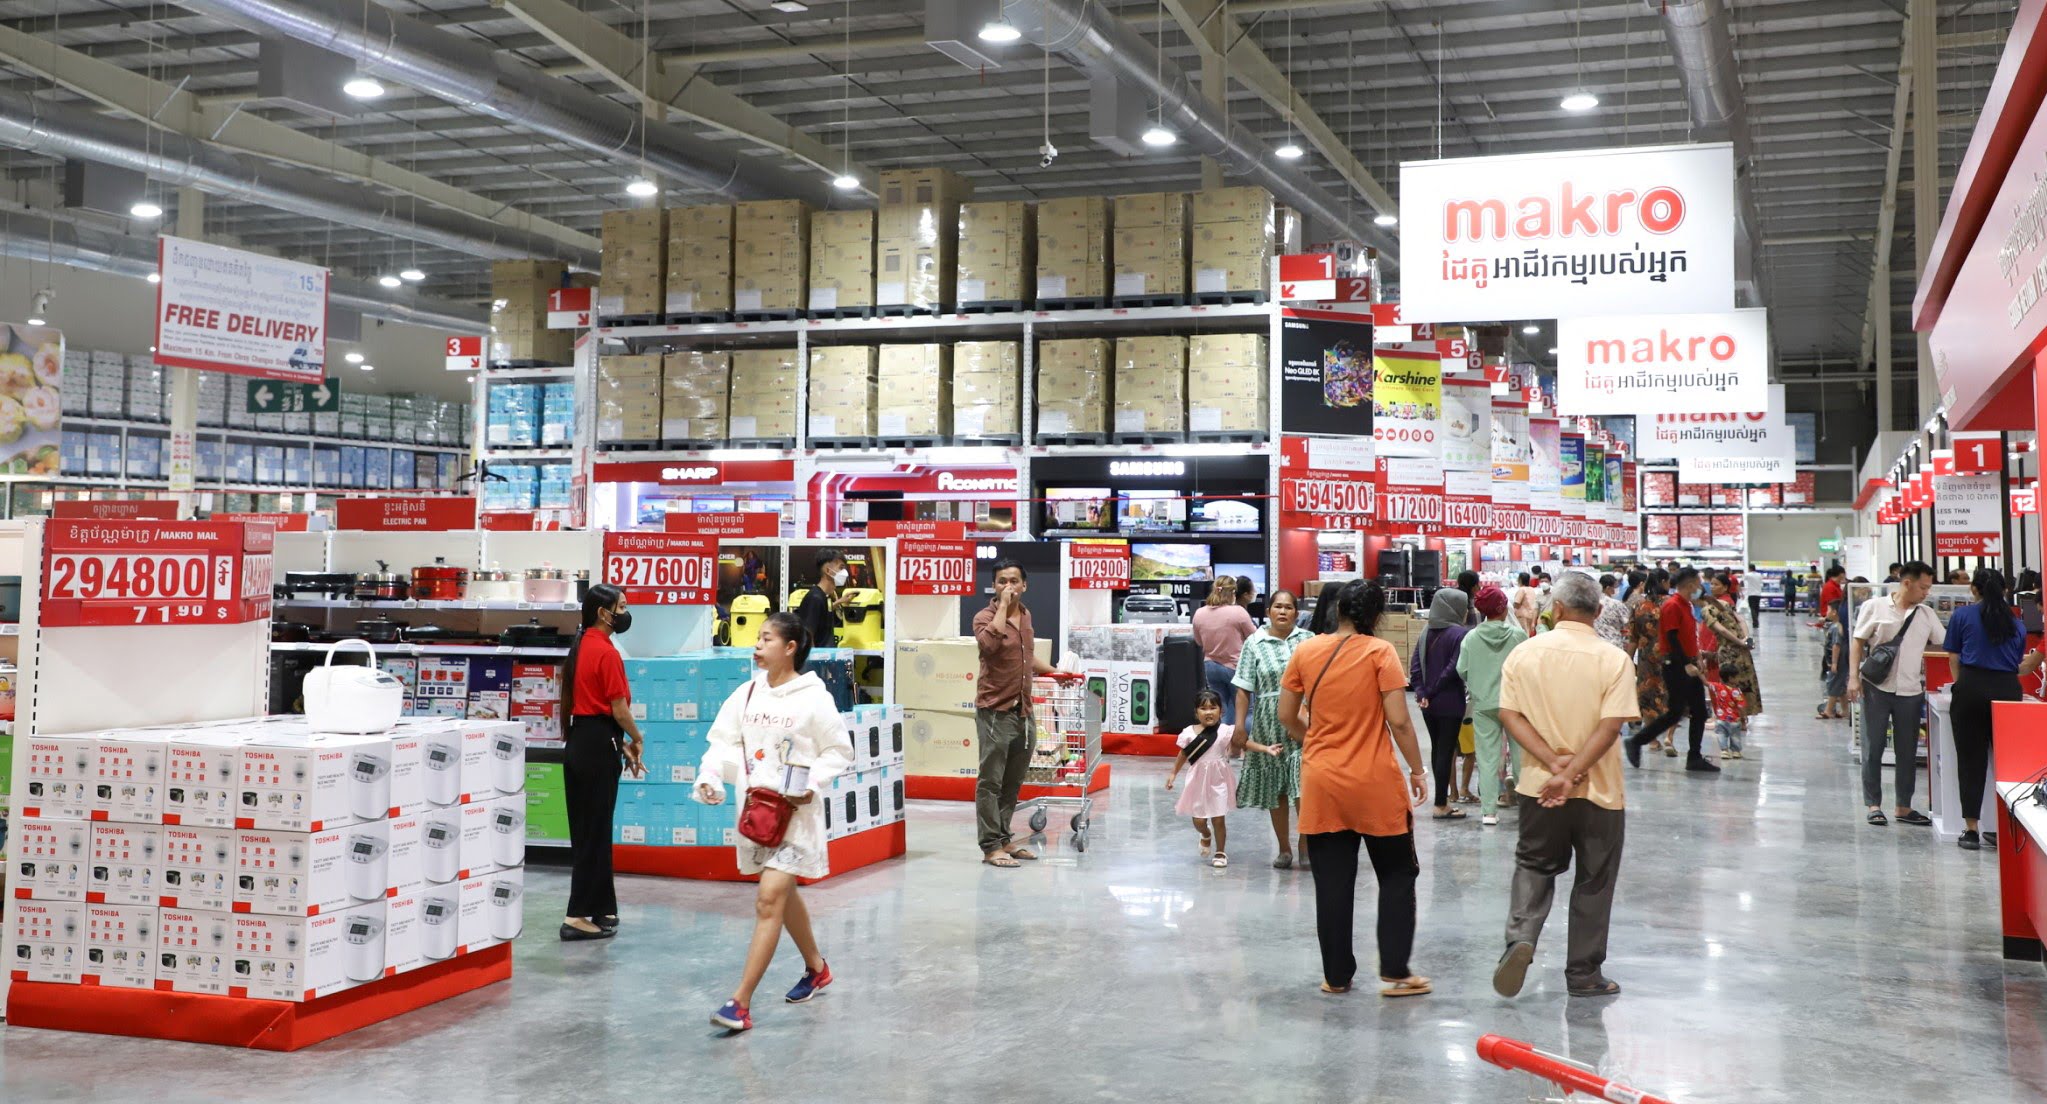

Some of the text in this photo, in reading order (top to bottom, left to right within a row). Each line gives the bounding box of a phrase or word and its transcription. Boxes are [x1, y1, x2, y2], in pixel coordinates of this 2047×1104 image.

[1443, 181, 1686, 244] makro
[1318, 254, 1333, 279] 1
[300, 274, 314, 291] 15
[1350, 279, 1367, 301] 2
[551, 290, 561, 310] 1
[165, 303, 220, 330] FREE
[227, 313, 319, 343] DELIVERY
[1416, 323, 1433, 339] 4
[449, 338, 461, 356] 3
[1450, 340, 1465, 358] 5
[1586, 328, 1736, 364] makro
[1468, 351, 1482, 369] 6
[1374, 368, 1436, 386] Karshine
[1494, 366, 1507, 382] 7
[1509, 375, 1520, 391] 8
[1529, 387, 1541, 402] 9
[1301, 440, 1308, 454] 1
[1971, 443, 1985, 467] 1
[662, 467, 718, 480] SHARP
[1110, 461, 1185, 476] SAMSUNG
[1297, 482, 1369, 511] 594500
[1390, 496, 1437, 519] 17200
[2014, 497, 2036, 511] 12
[383, 517, 427, 525] ELECTRIC PAN
[1448, 504, 1487, 524] 16400
[197, 530, 219, 541] MAIL
[721, 527, 744, 535] CLEANER
[691, 540, 704, 548] MAIL
[610, 556, 698, 585] 327600
[903, 559, 962, 580] 125100
[1070, 560, 1123, 577] 1102900
[52, 556, 206, 598] 294800
[703, 592, 710, 602] $
[217, 606, 228, 619] $
[1112, 700, 1118, 710] OF
[1118, 673, 1129, 732] VD Audio
[465, 732, 485, 741] TOSHIBA
[100, 746, 128, 754] TOSHIBA
[172, 749, 201, 758] TOSHIBA
[395, 742, 417, 751] TOSHIBA
[245, 752, 274, 760] TOSHIBA
[319, 752, 343, 761] TOSHIBA
[465, 807, 485, 816] TOSHIBA
[96, 827, 125, 835] TOSHIBA
[393, 821, 416, 830] TOSHIBA
[168, 831, 197, 839] TOSHIBA
[241, 835, 271, 843] TOSHIBA
[315, 835, 340, 844] TOSHIBA
[463, 881, 483, 891] TOSHIBA
[391, 899, 414, 909] TOSHIBA
[91, 909, 120, 917] TOSHIBA
[164, 913, 193, 922] TOSHIBA
[237, 919, 267, 928] TOSHIBA
[311, 917, 336, 928] TOSHIBA
